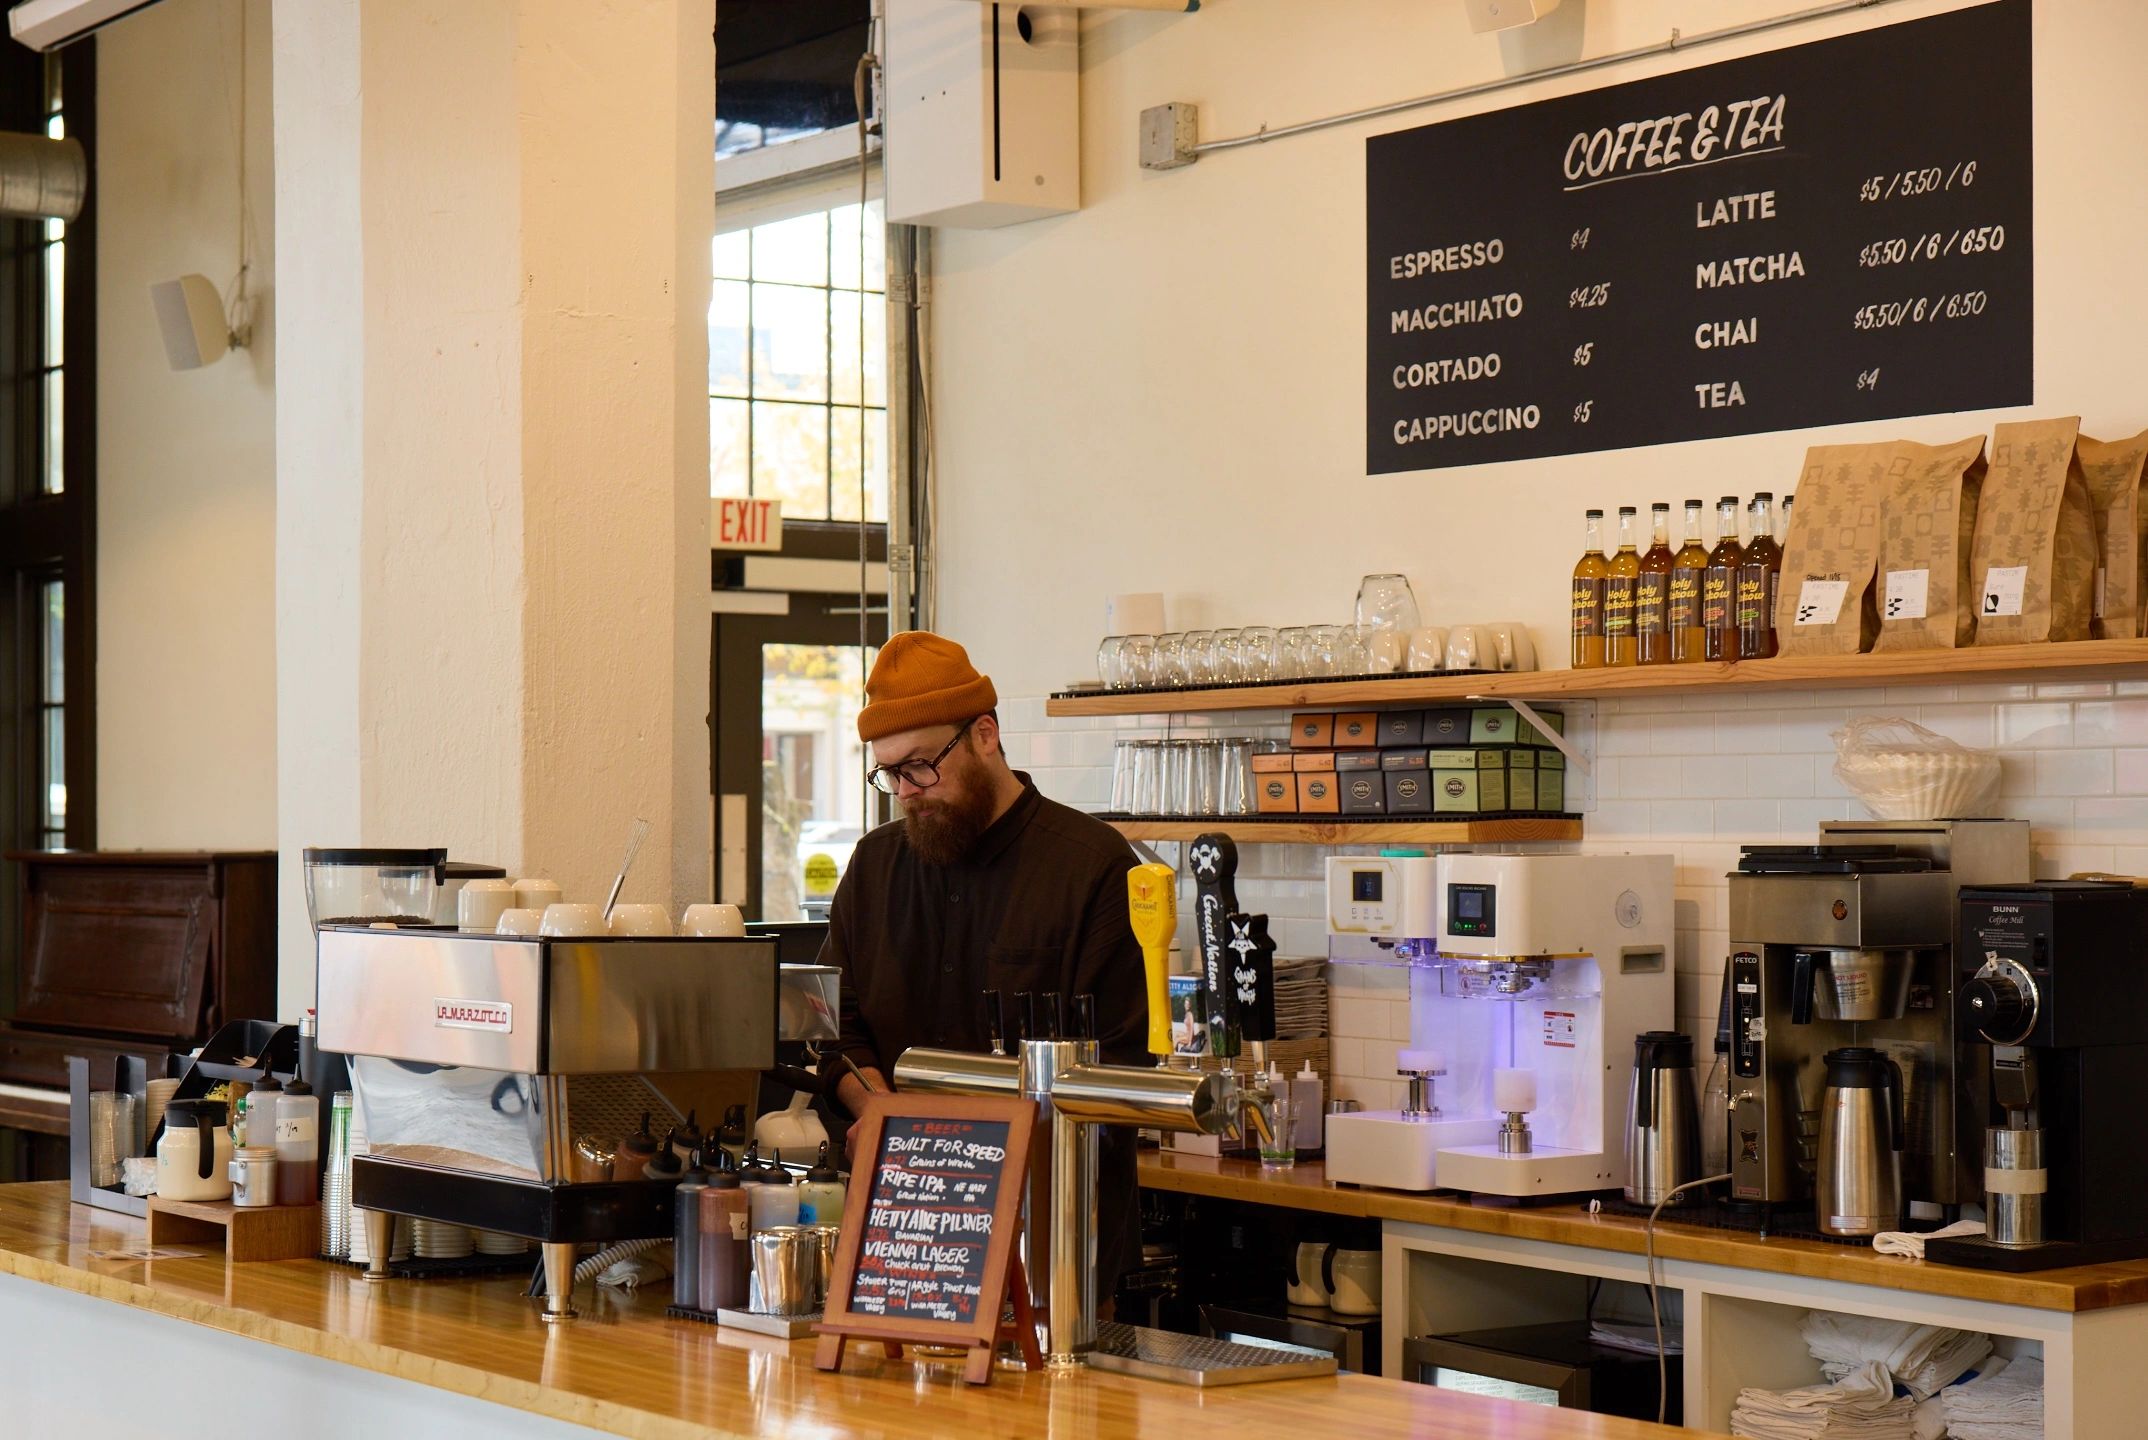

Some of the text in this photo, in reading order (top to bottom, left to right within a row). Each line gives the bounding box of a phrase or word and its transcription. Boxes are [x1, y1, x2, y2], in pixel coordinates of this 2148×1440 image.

[1564, 94, 1786, 180] COFFEE & TEA
[1860, 176, 1884, 202] $5
[1697, 191, 1776, 228] LATTE
[1571, 229, 1590, 250] $4
[1391, 238, 1504, 279] ESPRESSO
[1697, 251, 1805, 289] MATCHA
[1569, 282, 1611, 309] $4.25
[1391, 292, 1523, 335] MACCHIATO
[1695, 317, 1757, 350] CHAI
[1573, 343, 1593, 367] $5
[1393, 352, 1501, 390] CORTADO
[1856, 367, 1880, 391] $4
[1695, 380, 1745, 409] TEA
[1394, 404, 1540, 445] CAPPUCCINO
[1573, 400, 1593, 426] $5
[720, 499, 771, 544] EXIT
[1352, 785, 1371, 794] SMITH
[1399, 783, 1417, 792] SMITH
[1446, 783, 1463, 792] SMITH
[1988, 916, 2008, 926] Coffee
[963, 1143, 1006, 1162] SPEED
[880, 1170, 919, 1188] RIPE
[940, 1212, 992, 1235] PILSNER
[865, 1240, 970, 1264] VIENNA LAGER
